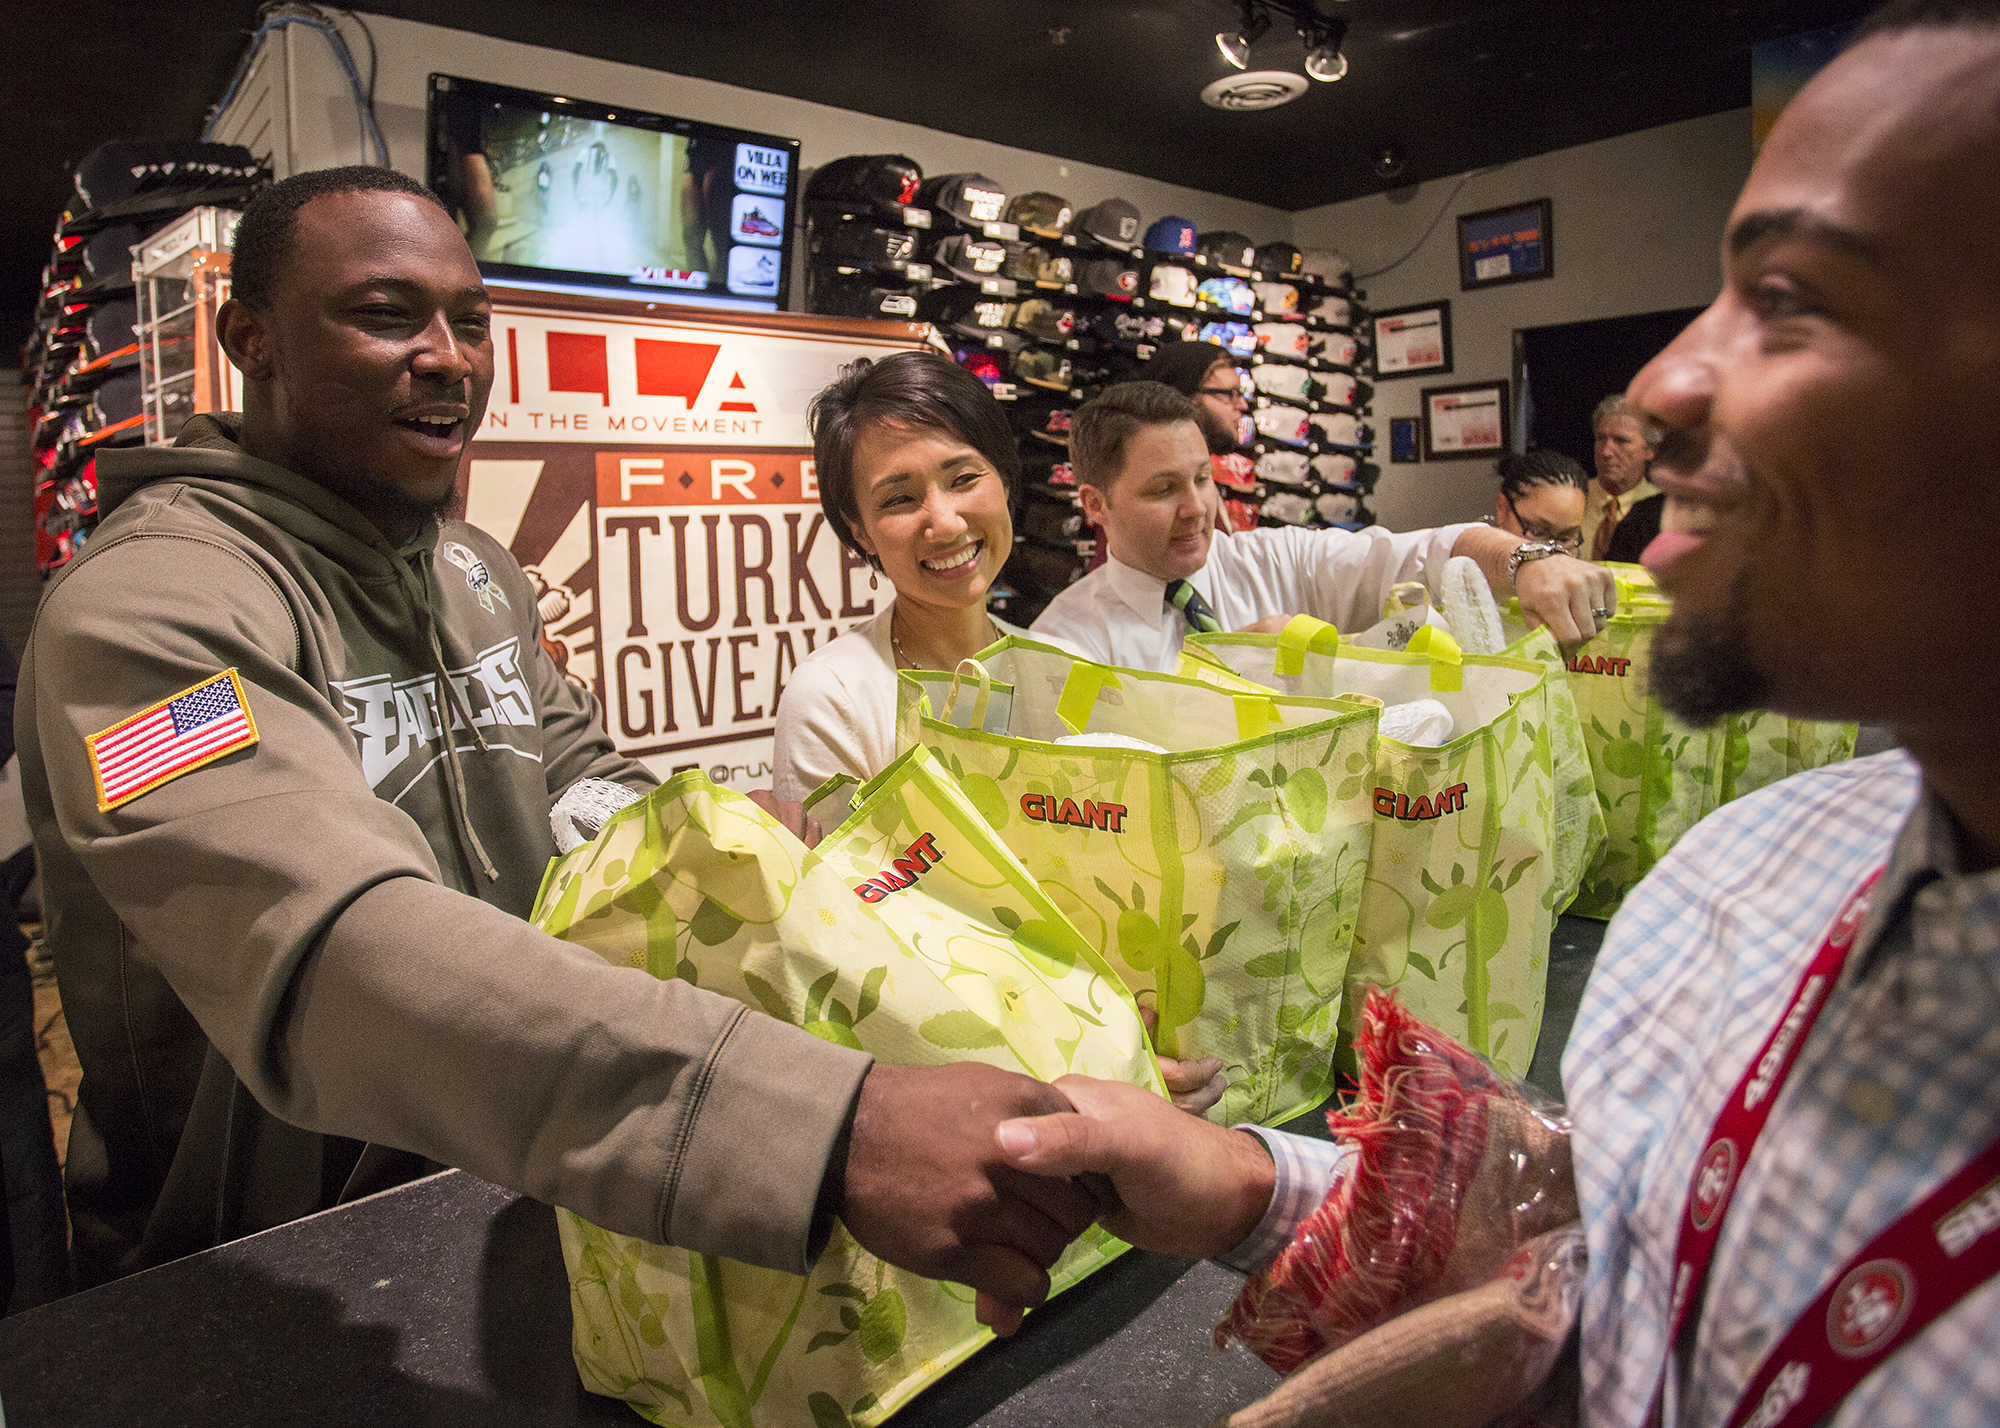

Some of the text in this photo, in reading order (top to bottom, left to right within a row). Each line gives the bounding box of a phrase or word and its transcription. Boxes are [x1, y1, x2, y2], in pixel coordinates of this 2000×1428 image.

[738, 165, 755, 180] ON
[747, 150, 782, 167] VILLA
[637, 266, 702, 285] VILLA
[491, 327, 758, 414] ILLA
[527, 411, 589, 430] THE
[608, 415, 763, 435] MOVEMENT
[619, 458, 820, 501] FRE
[605, 512, 875, 638] TURKE
[616, 627, 839, 739] GIVEA
[1565, 654, 1632, 677] IANT
[709, 761, 774, 784] @ruv
[1020, 792, 1128, 834] GIANT
[1373, 781, 1468, 821] GIANT
[853, 831, 944, 904] GIANT
